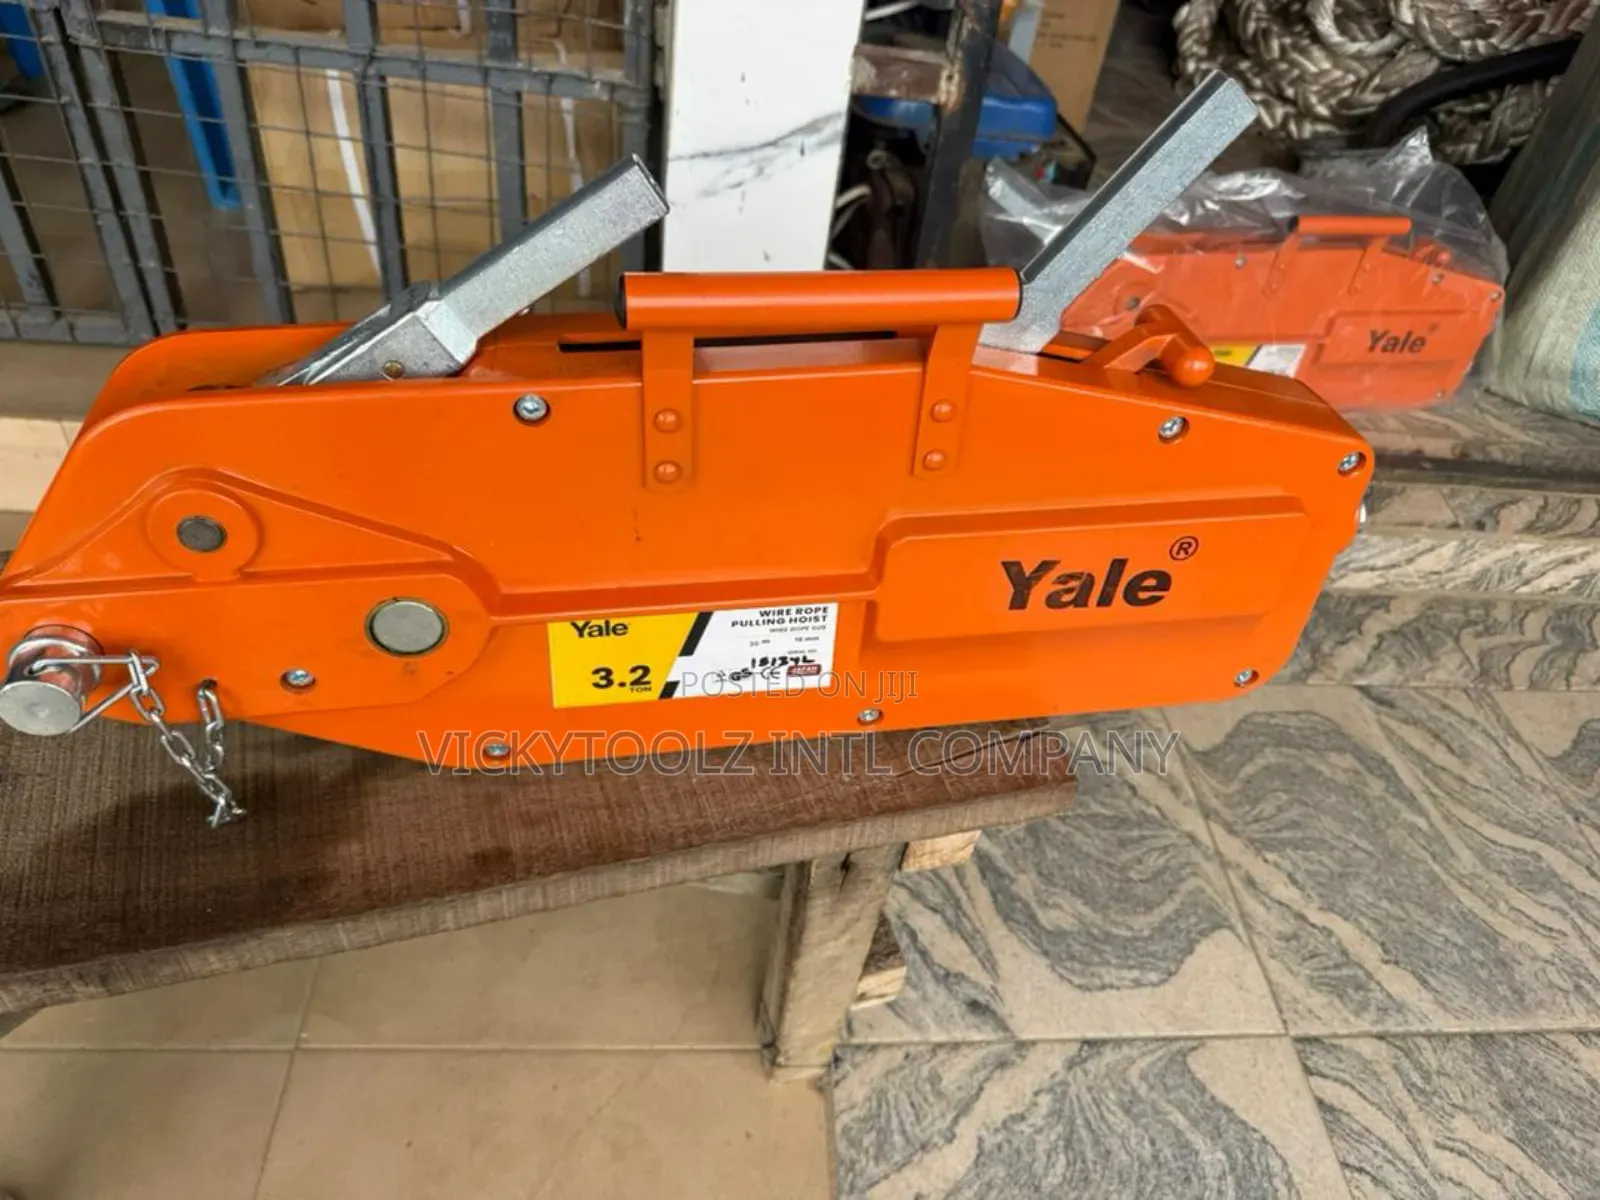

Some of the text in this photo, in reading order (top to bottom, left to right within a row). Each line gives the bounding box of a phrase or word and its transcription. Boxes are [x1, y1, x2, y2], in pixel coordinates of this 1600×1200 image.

[1367, 330, 1427, 353] Yale
[1001, 558, 1173, 610] Yale
[731, 614, 829, 628] PULLING HOIST
[759, 606, 829, 618] WIRE ROPE
[570, 619, 629, 638] Yale
[591, 664, 652, 690] 3.2
